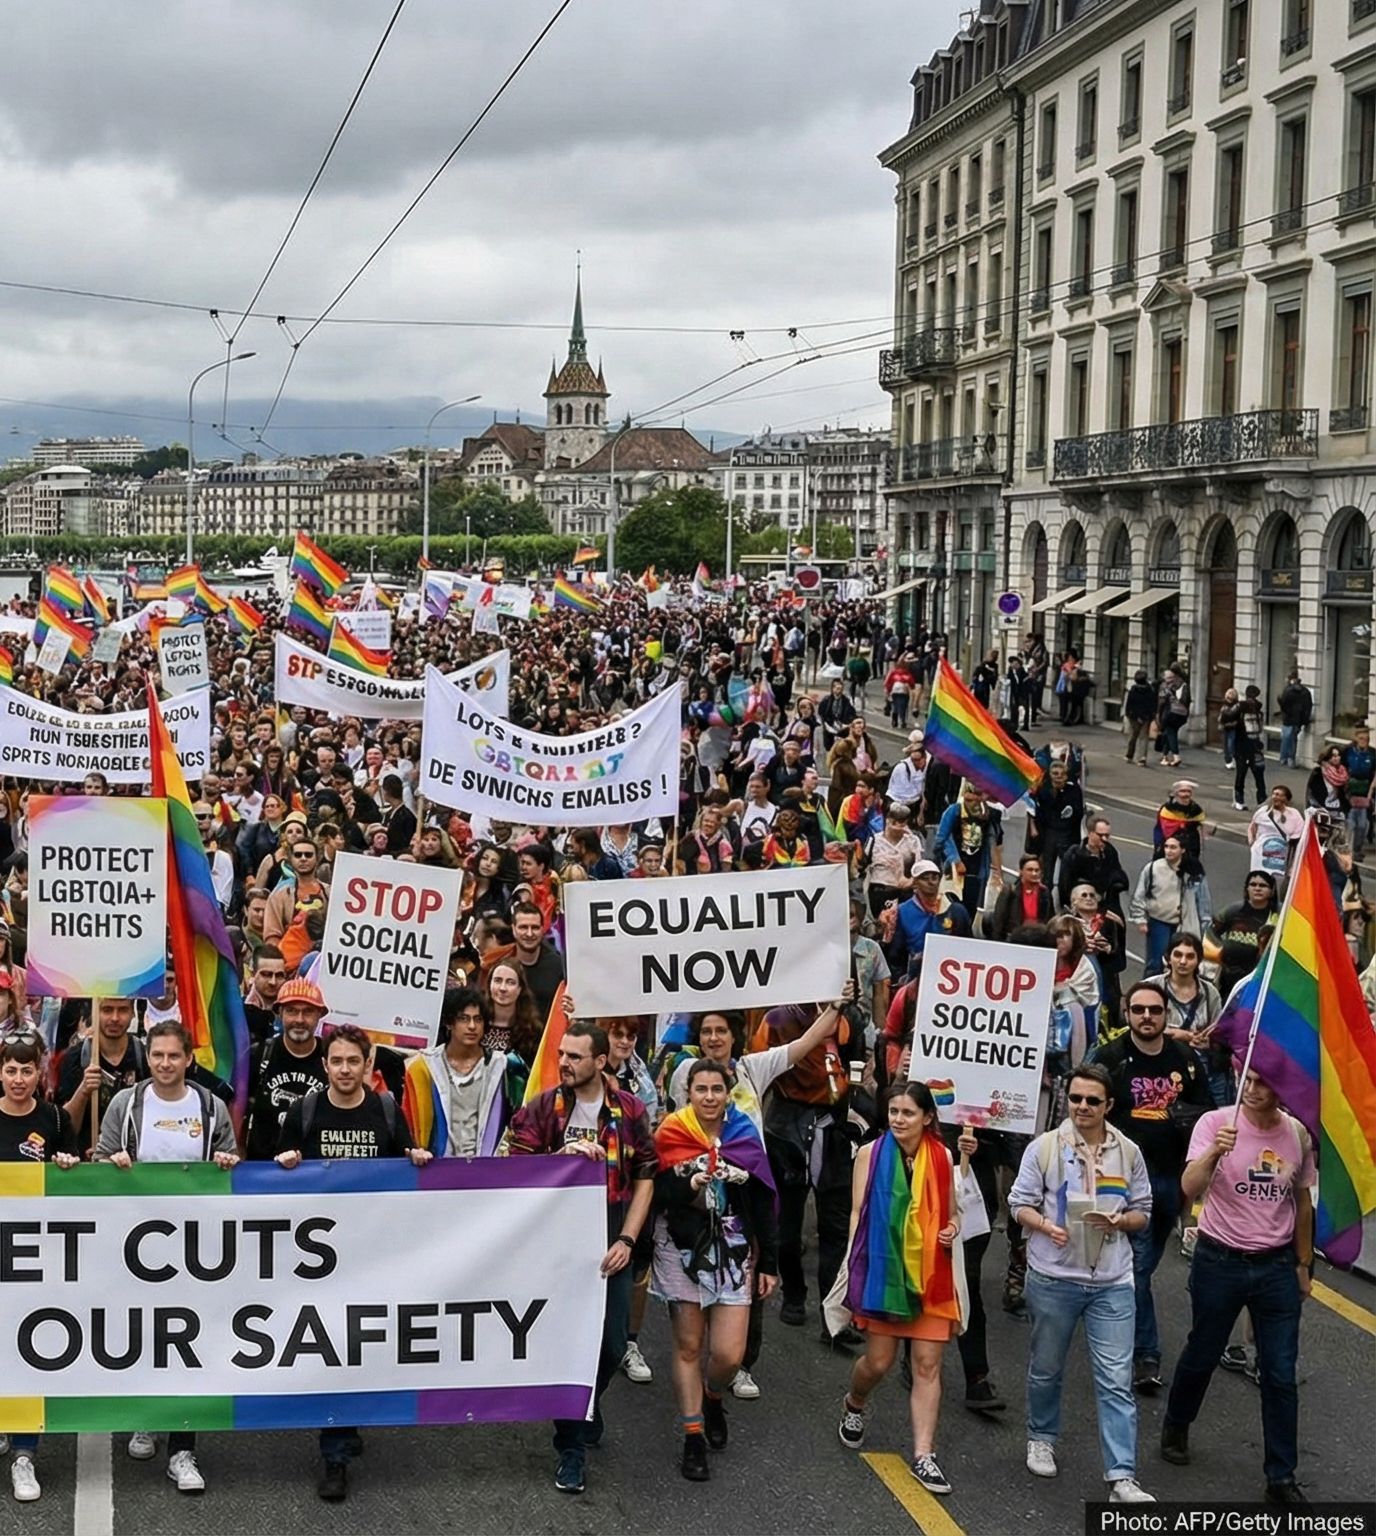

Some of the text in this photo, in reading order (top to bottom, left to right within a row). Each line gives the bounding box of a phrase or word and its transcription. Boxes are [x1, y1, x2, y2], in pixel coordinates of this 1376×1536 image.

[429, 758, 457, 785] DE
[562, 779, 652, 809] ENALISS
[41, 846, 154, 872] PROTECT
[38, 879, 156, 906] LGBTQIA+
[344, 878, 443, 924] STOP
[590, 888, 826, 938] EQUALITY
[51, 912, 143, 939] RIGHTS
[339, 921, 433, 960] SOCIAL
[327, 952, 441, 992] VIOLENCE
[642, 947, 778, 993] NOW
[937, 959, 1037, 1003] STOP
[931, 1002, 1030, 1038] SOCIAL
[920, 1033, 1038, 1070] VIOLENCE
[124, 1217, 338, 1282] CUTS
[18, 1307, 203, 1371] OUR
[231, 1299, 549, 1368] SAFETY
